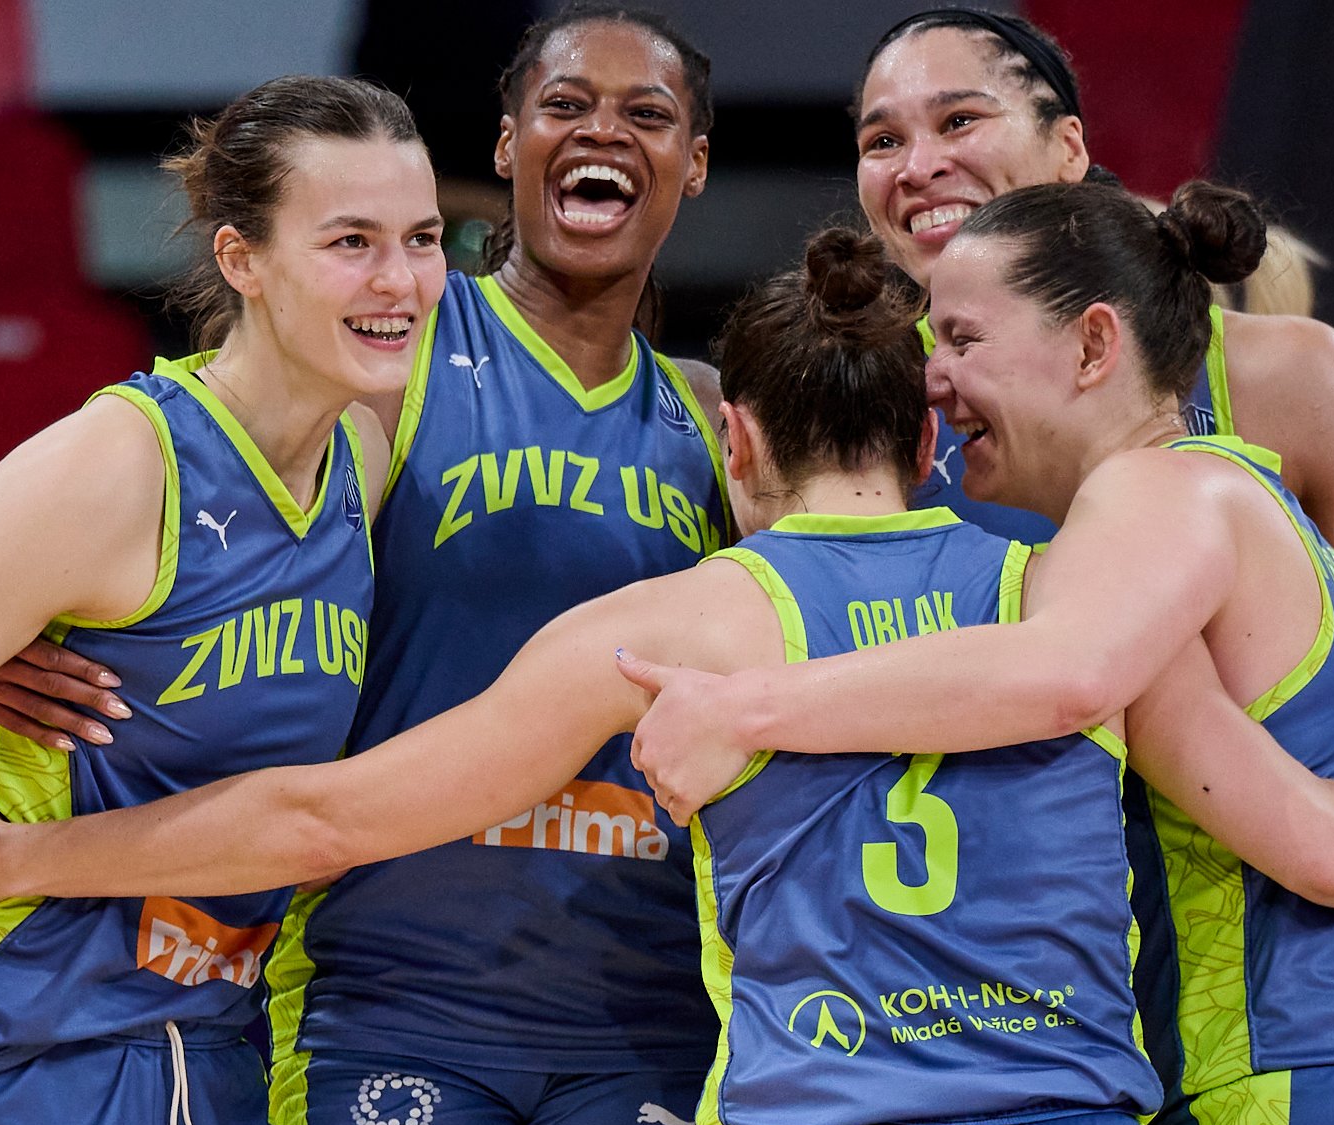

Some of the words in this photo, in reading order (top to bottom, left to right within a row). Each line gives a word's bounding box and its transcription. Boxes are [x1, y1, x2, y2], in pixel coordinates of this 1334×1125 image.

[433, 445, 604, 550] ZVVZ
[155, 598, 305, 706] ZVVZ
[862, 752, 959, 916] 3
[891, 1016, 963, 1044] Mladá
